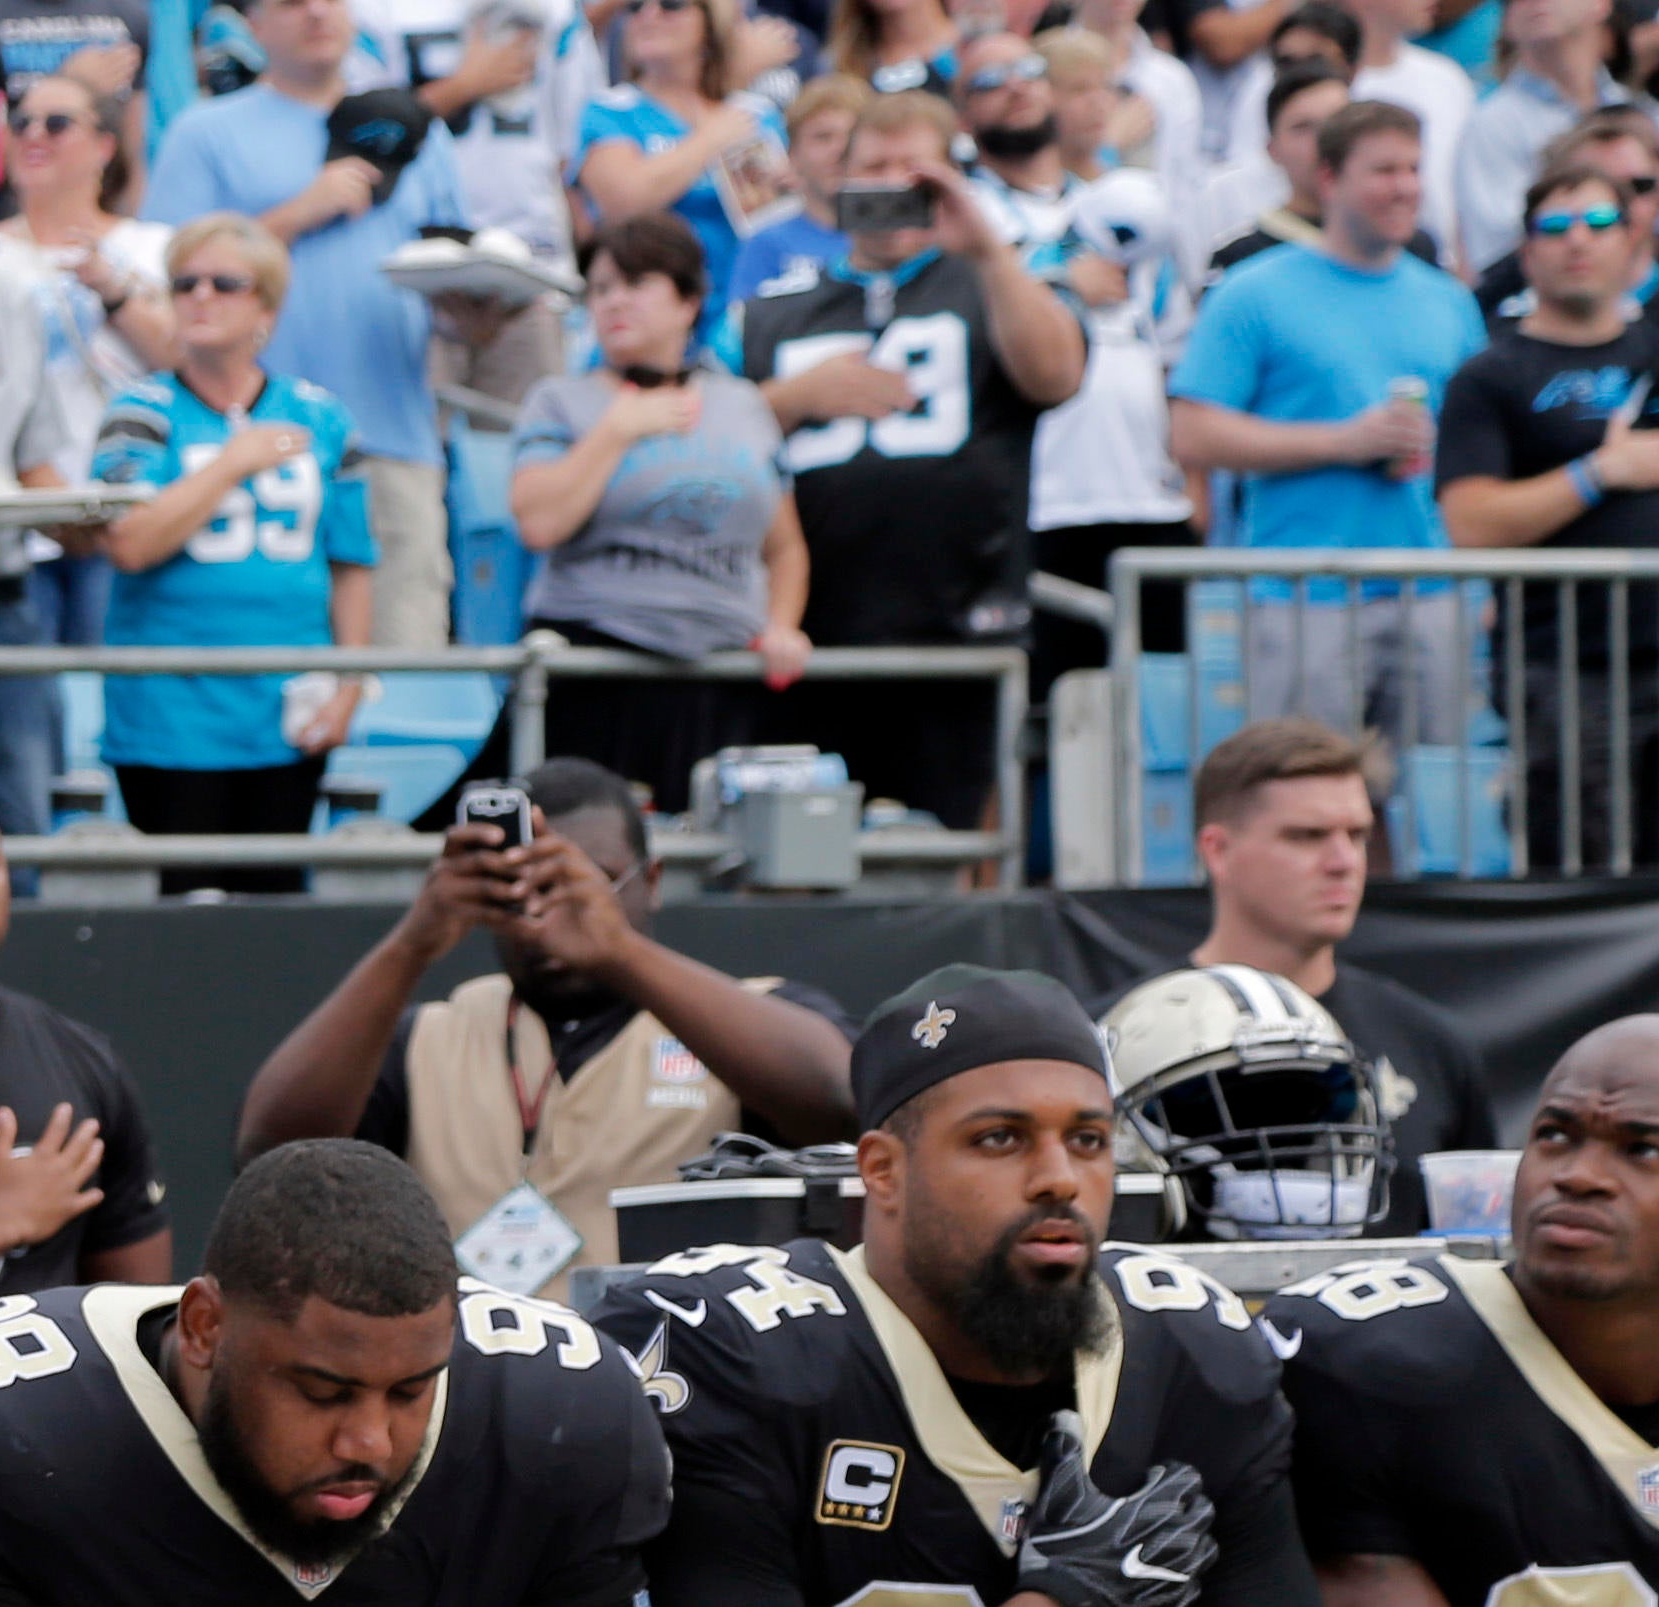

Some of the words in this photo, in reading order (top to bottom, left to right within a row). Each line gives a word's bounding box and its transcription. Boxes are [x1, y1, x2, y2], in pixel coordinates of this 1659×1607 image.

[458, 1276, 601, 1367] 9
[1099, 1241, 1251, 1330] 9
[825, 1446, 896, 1506] C
